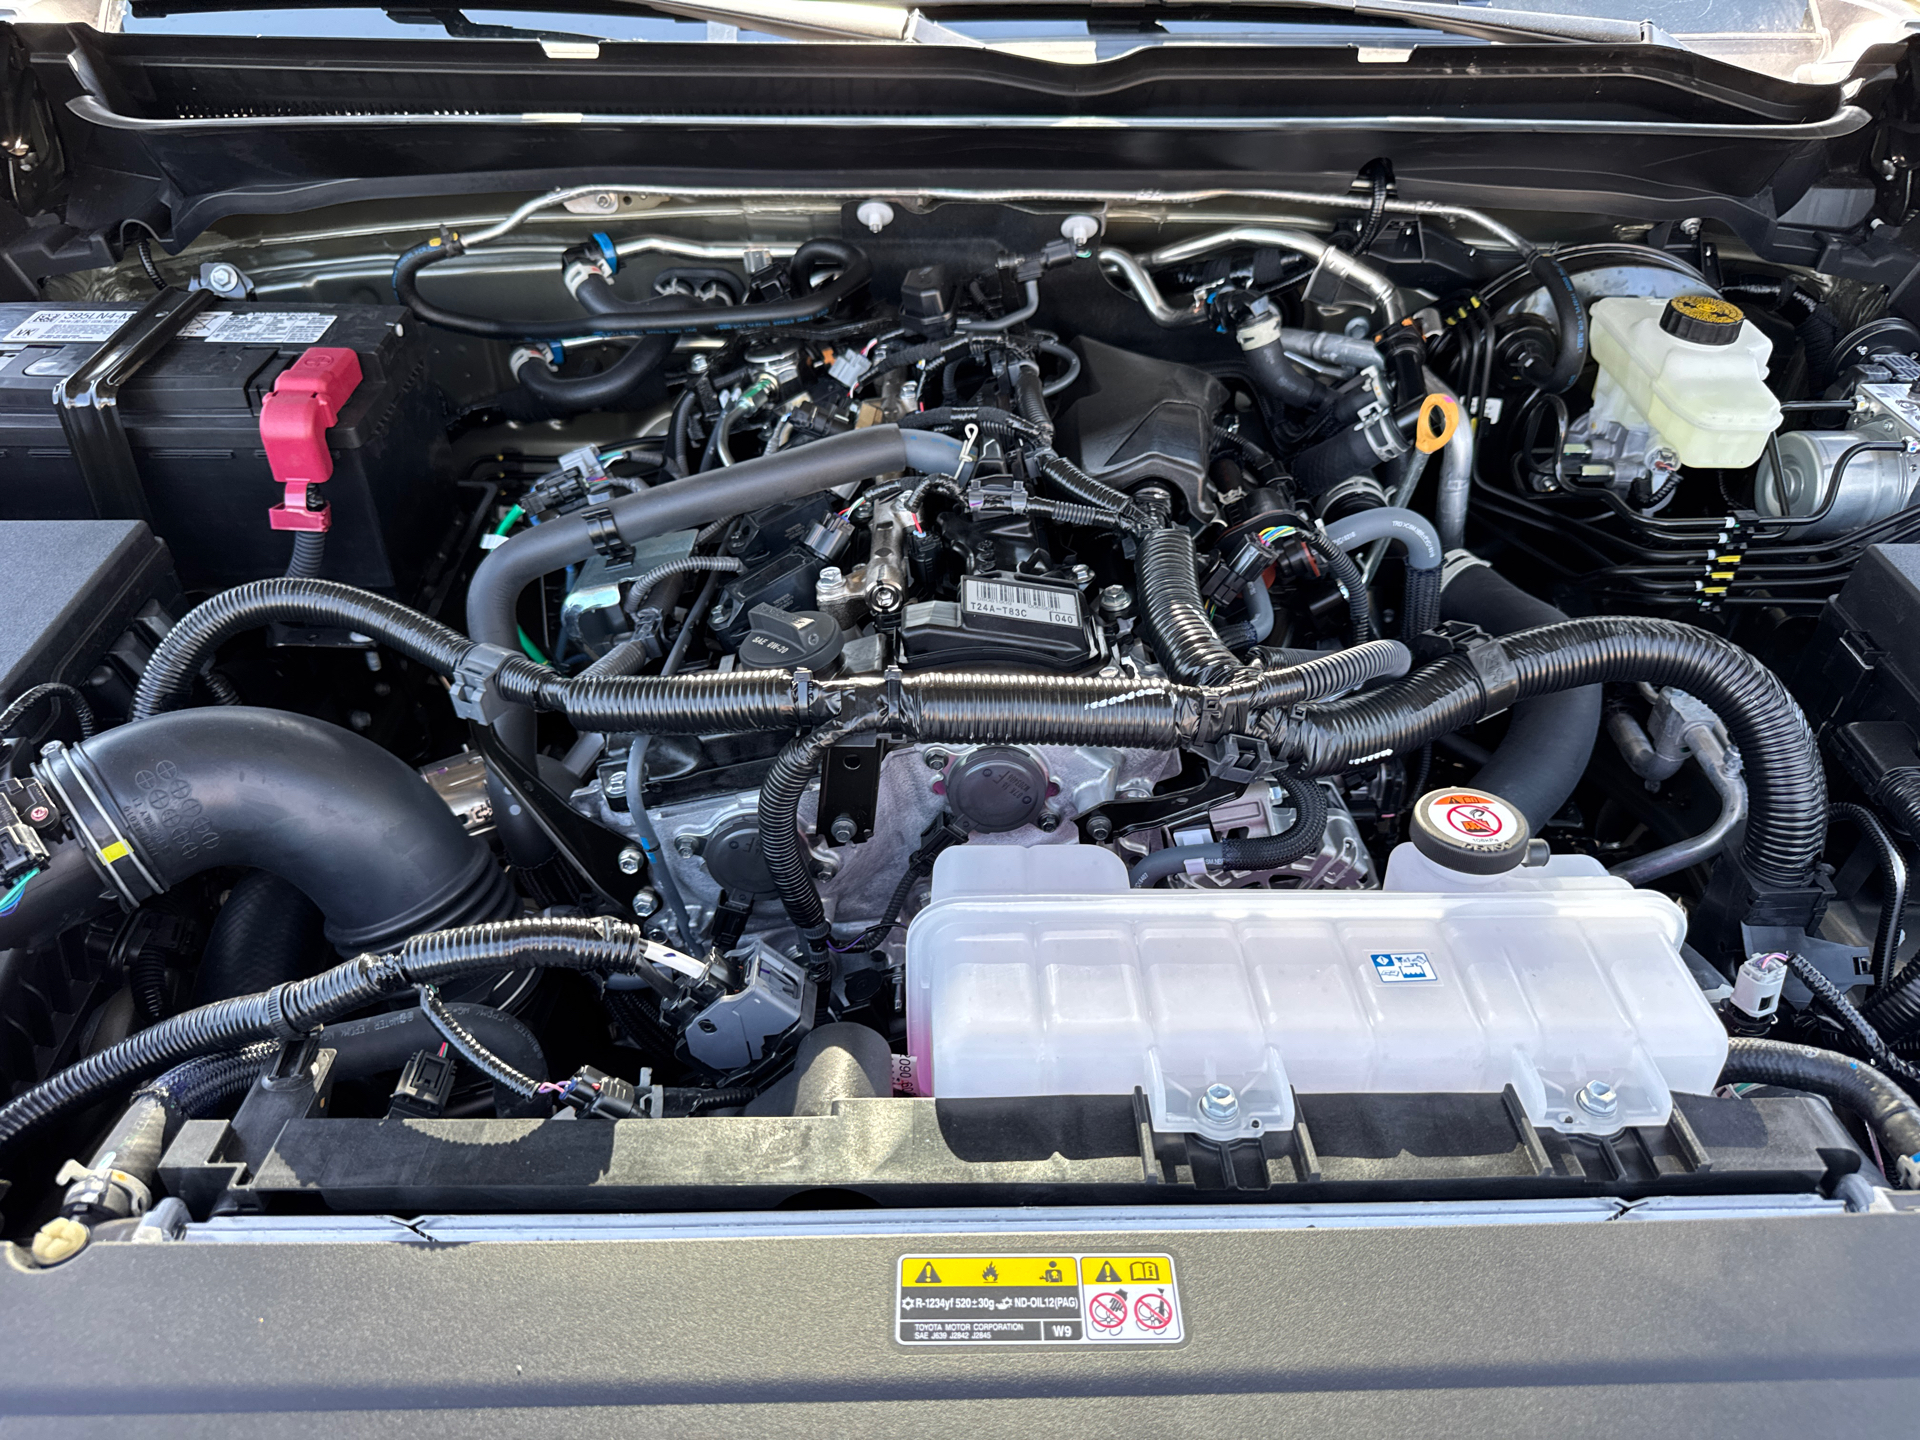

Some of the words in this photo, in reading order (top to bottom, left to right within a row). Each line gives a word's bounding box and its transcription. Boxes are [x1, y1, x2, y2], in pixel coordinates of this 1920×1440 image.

[970, 602, 1027, 618] T24A-T83C
[1055, 614, 1074, 624] 040
[752, 636, 769, 646] SAE
[767, 641, 790, 654] 0W-20
[915, 1297, 954, 1310] R-1234yf
[955, 1297, 995, 1311] 520±30g
[1014, 1297, 1078, 1309] ND-OIL12(PAG)
[914, 1323, 943, 1331] TOYOTA
[945, 1323, 971, 1331] MOTOR
[973, 1323, 1024, 1331] CORPORATION
[1052, 1325, 1073, 1338] W9
[914, 1332, 929, 1340] SAE
[930, 1332, 948, 1340] J639
